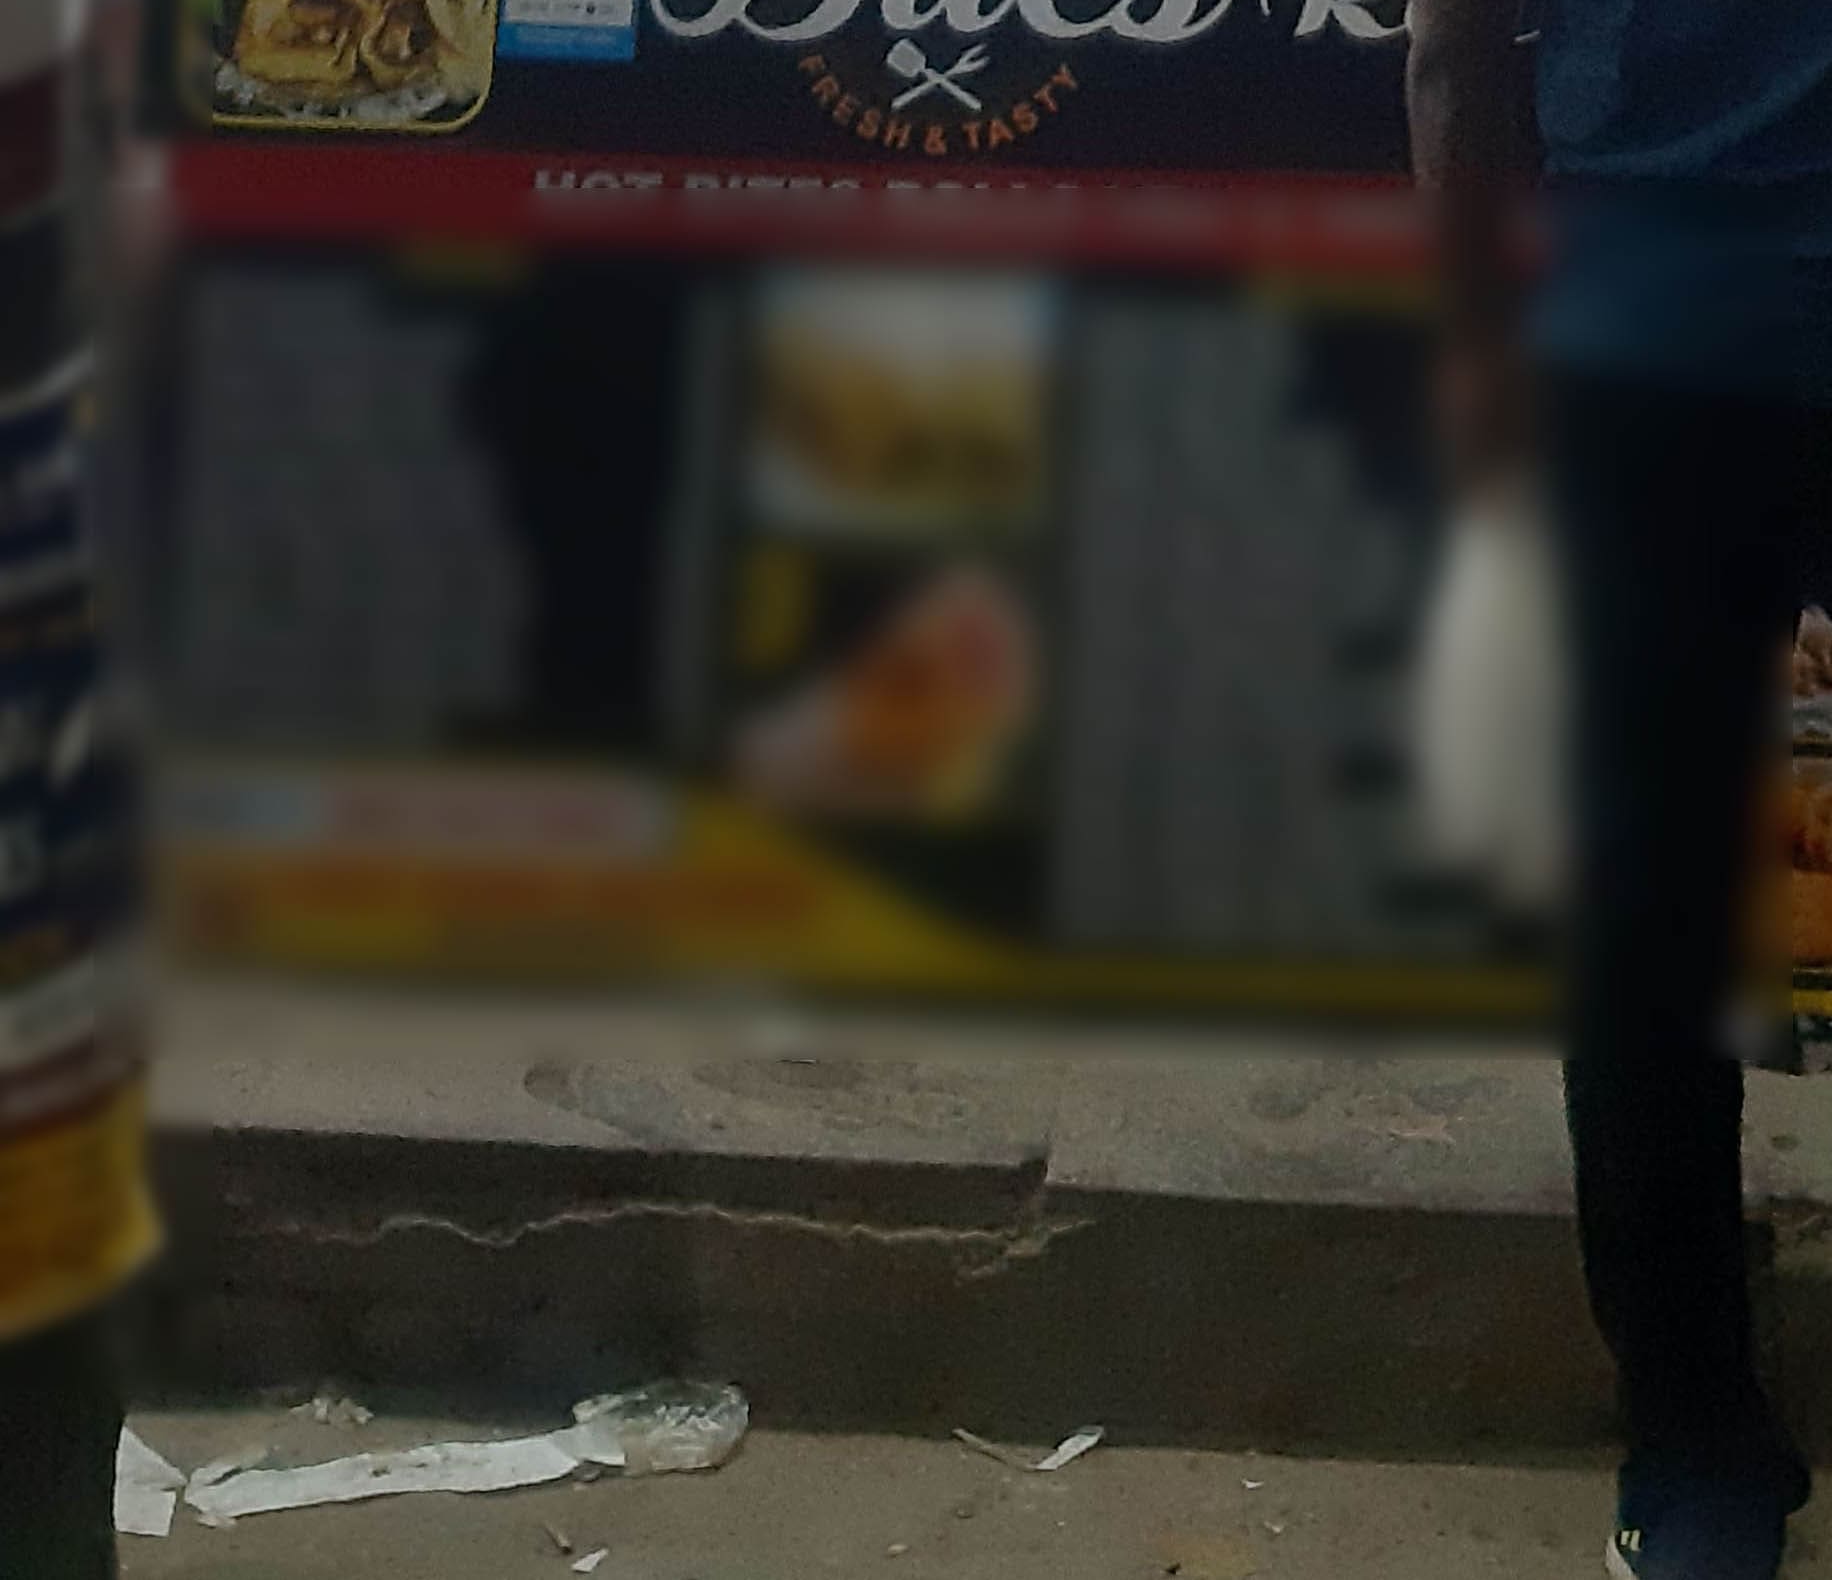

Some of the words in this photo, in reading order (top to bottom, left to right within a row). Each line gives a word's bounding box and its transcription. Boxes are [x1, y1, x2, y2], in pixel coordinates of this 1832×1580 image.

[800, 53, 911, 148] FRESH
[924, 121, 947, 156] &
[966, 64, 1078, 149] TASTY
